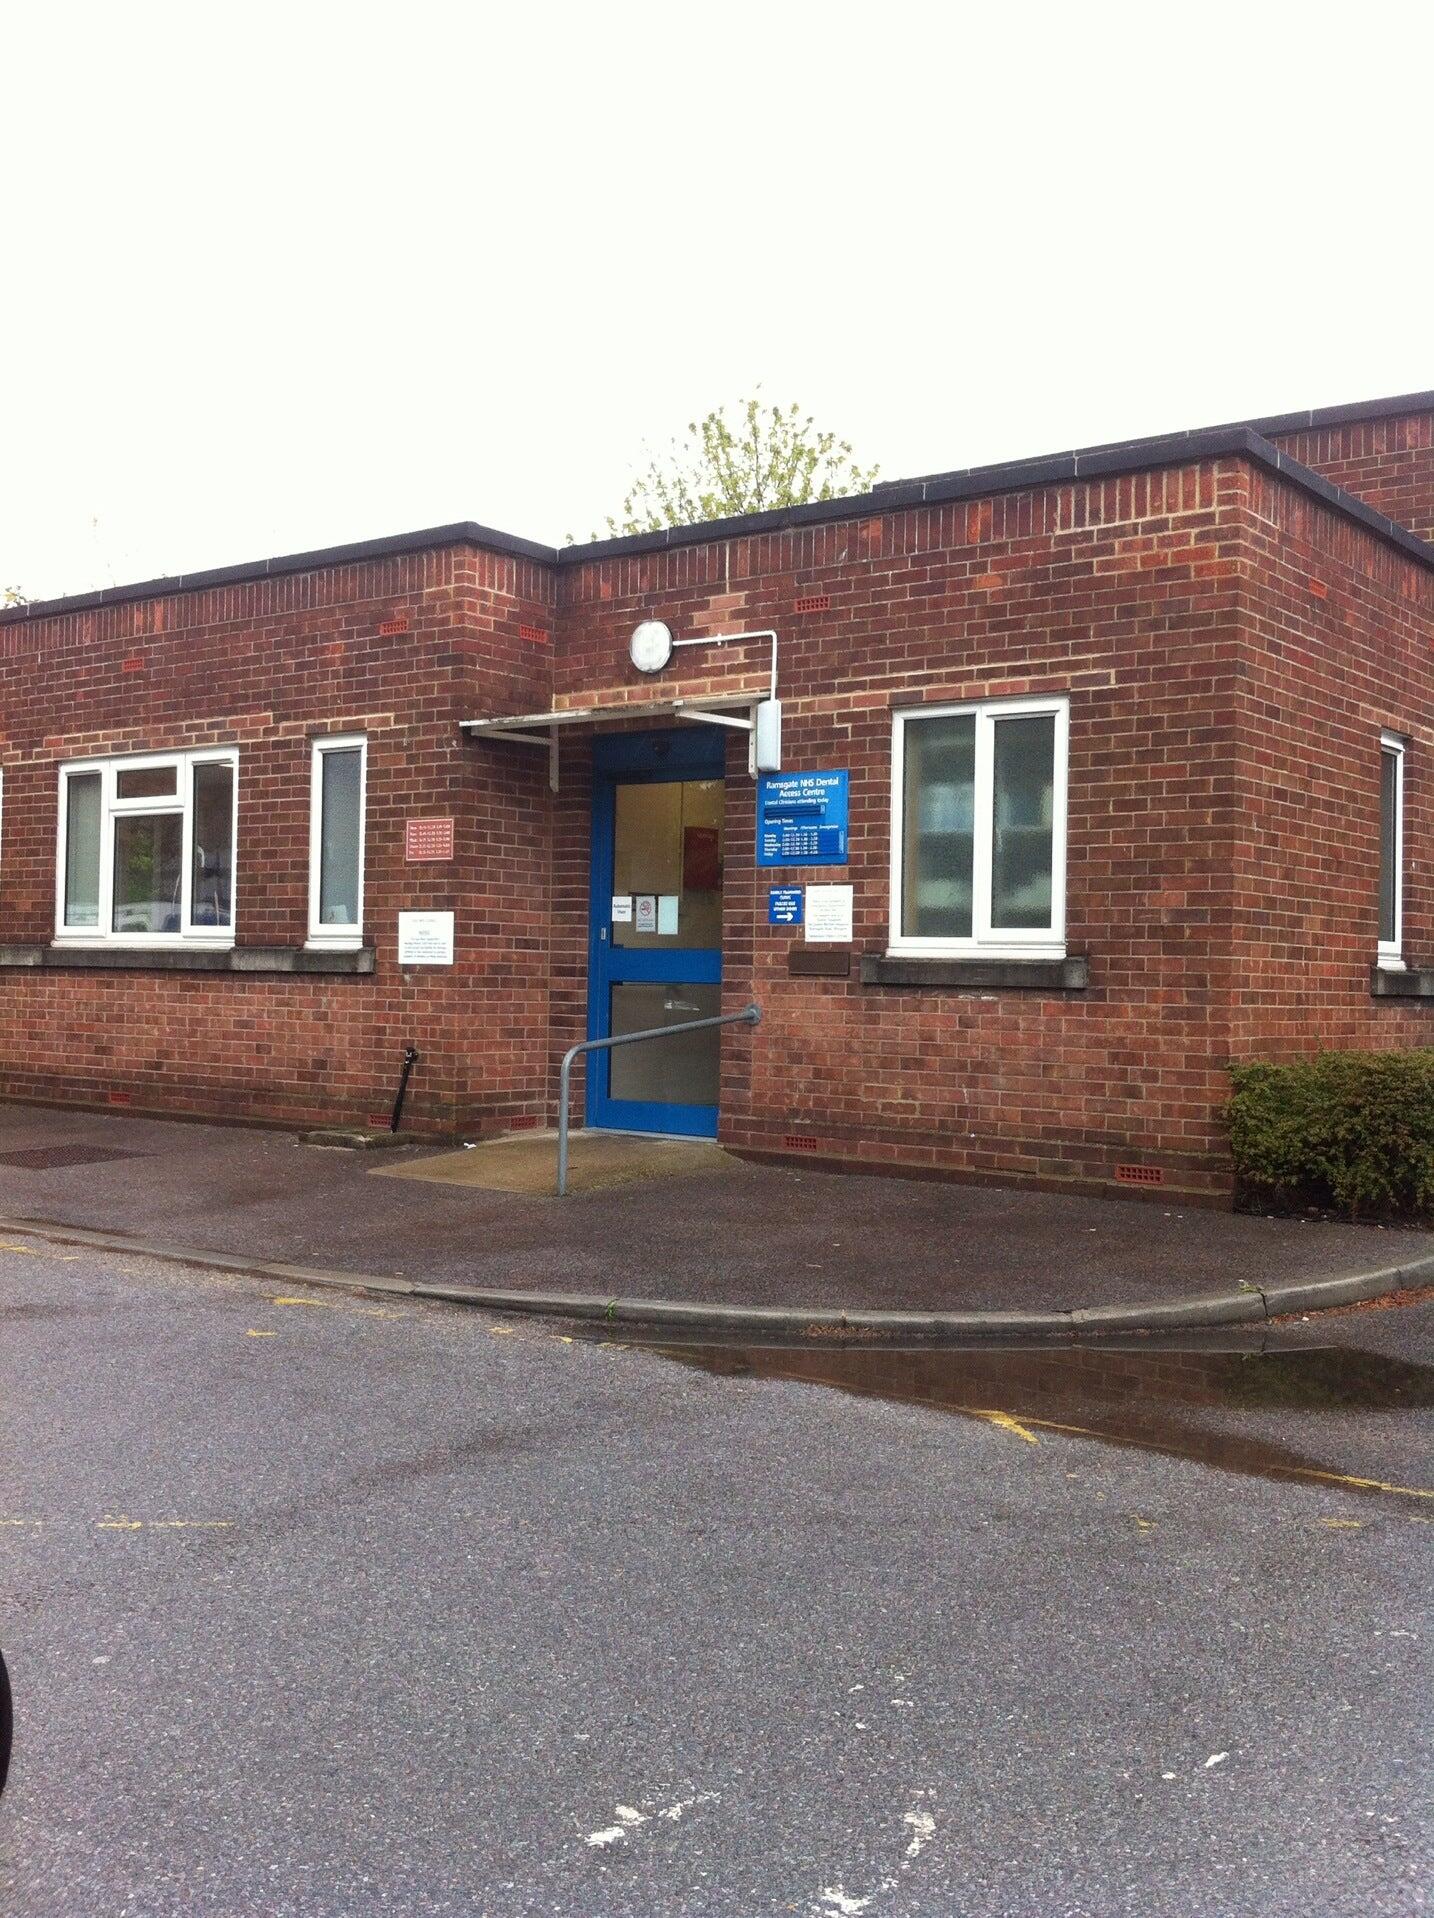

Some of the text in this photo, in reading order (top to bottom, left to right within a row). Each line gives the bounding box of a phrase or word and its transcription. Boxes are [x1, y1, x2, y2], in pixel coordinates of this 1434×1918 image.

[766, 777, 839, 790] Ramsgate NHS Dental
[779, 788, 826, 798] Access Centre
